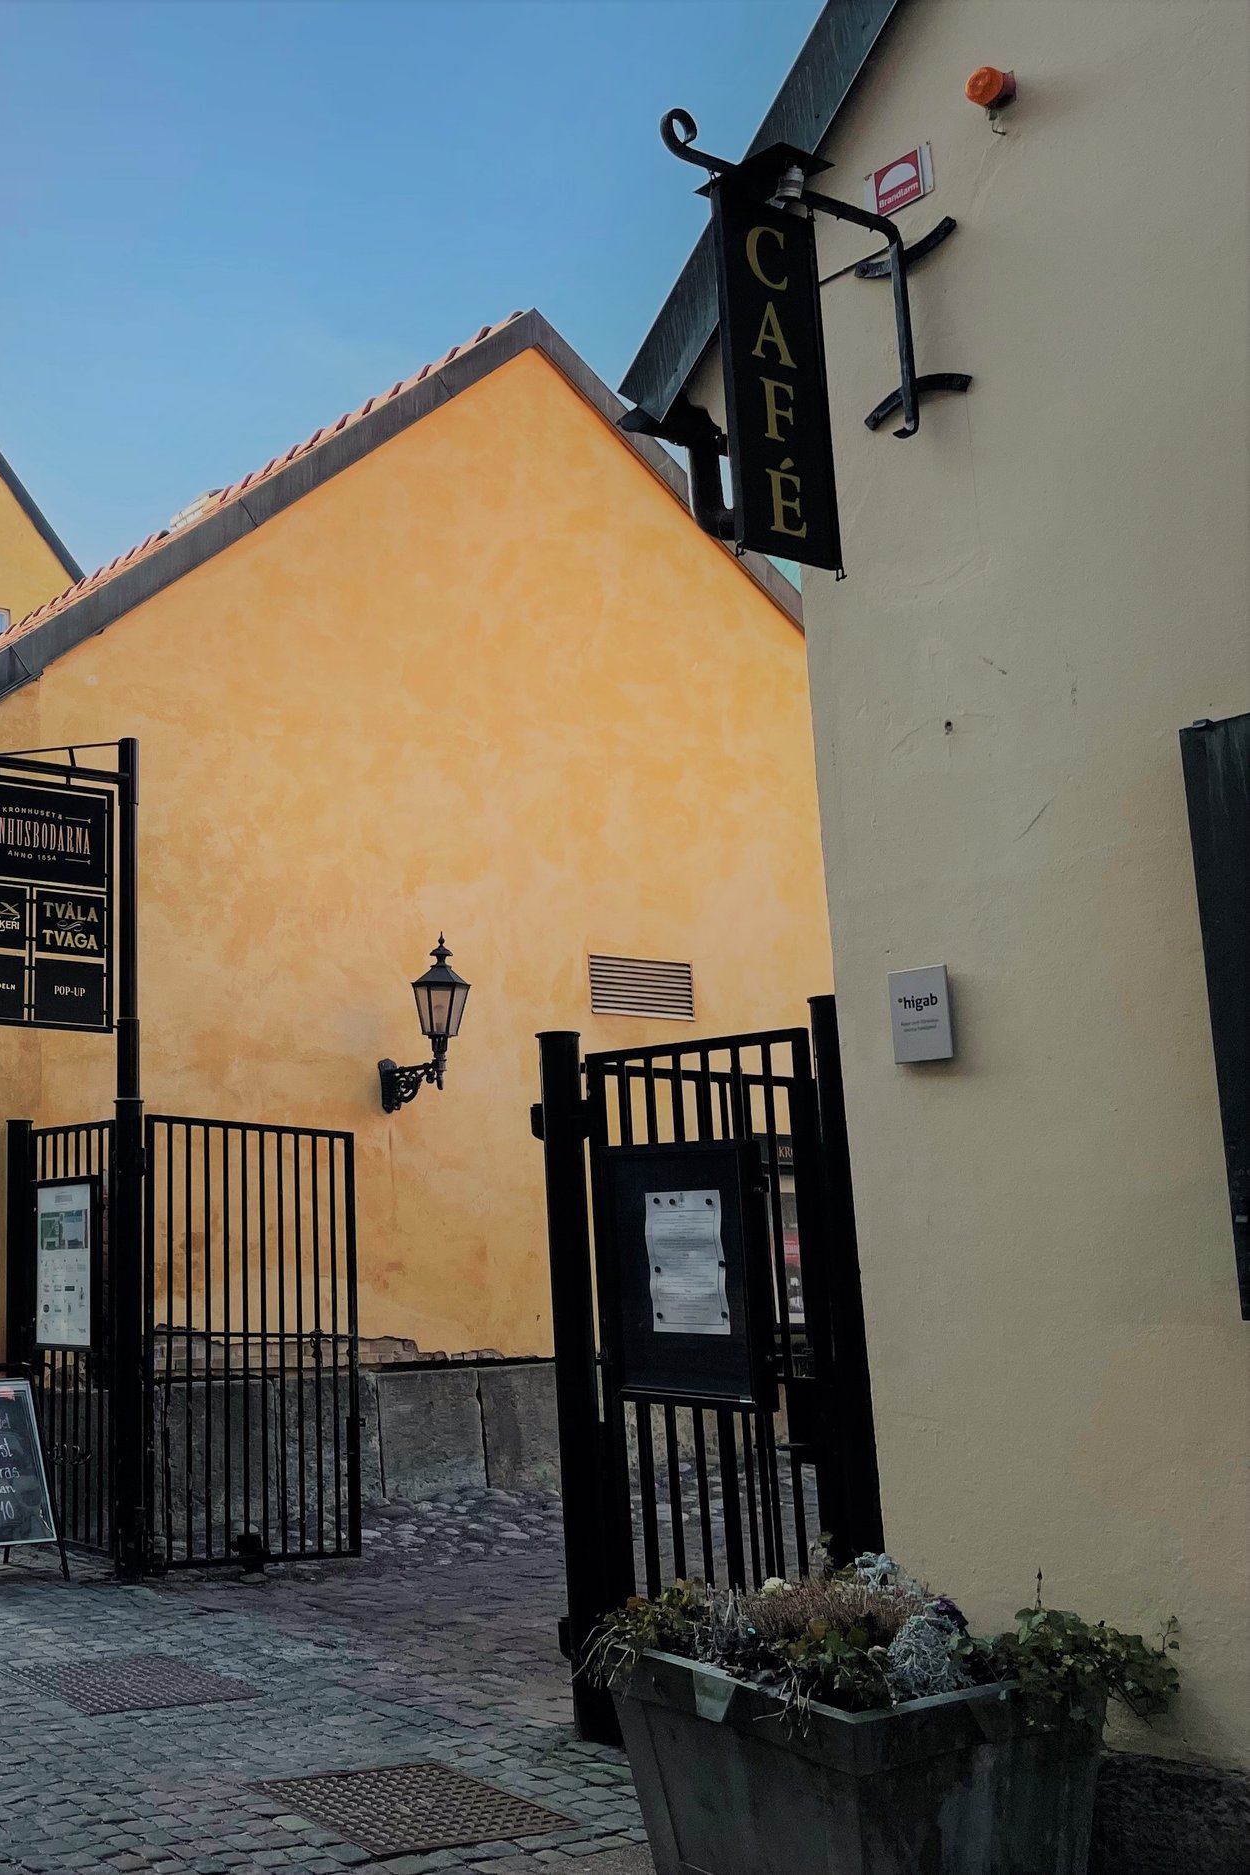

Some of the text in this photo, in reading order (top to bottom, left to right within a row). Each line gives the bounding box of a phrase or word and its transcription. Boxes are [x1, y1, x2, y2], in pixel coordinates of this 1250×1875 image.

[878, 182, 919, 209] Brandlarm
[744, 225, 808, 539] CAFÉ
[2, 806, 56, 818] KRONHUSET
[7, 850, 33, 860] ANNO
[42, 901, 99, 923] TVÅLA
[42, 929, 99, 950] TVAGA
[54, 985, 86, 997] POP-UP
